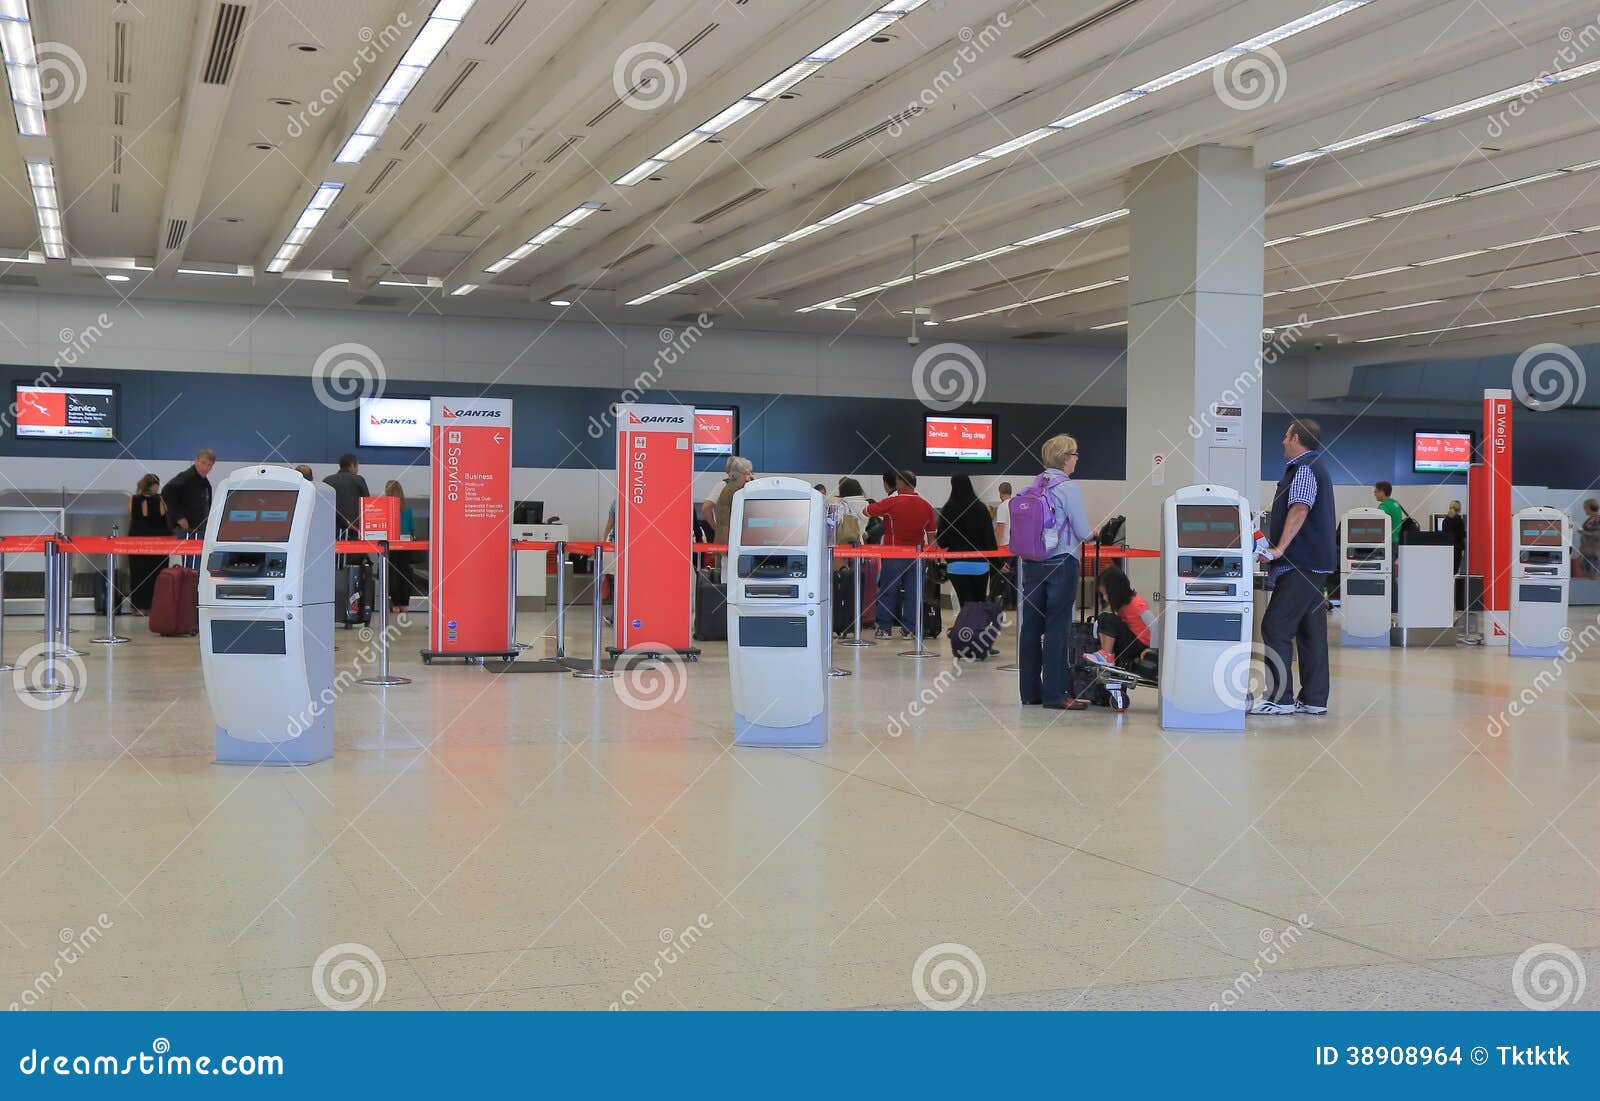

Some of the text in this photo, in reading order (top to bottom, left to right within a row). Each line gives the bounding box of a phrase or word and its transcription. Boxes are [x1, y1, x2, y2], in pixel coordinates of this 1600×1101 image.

[68, 404, 96, 412] Service
[454, 409, 501, 418] QANTAS
[640, 416, 684, 424] QANTAS
[1495, 417, 1506, 454] Weigh
[448, 447, 463, 501] Service
[464, 472, 493, 480] Business
[633, 452, 647, 504] Service
